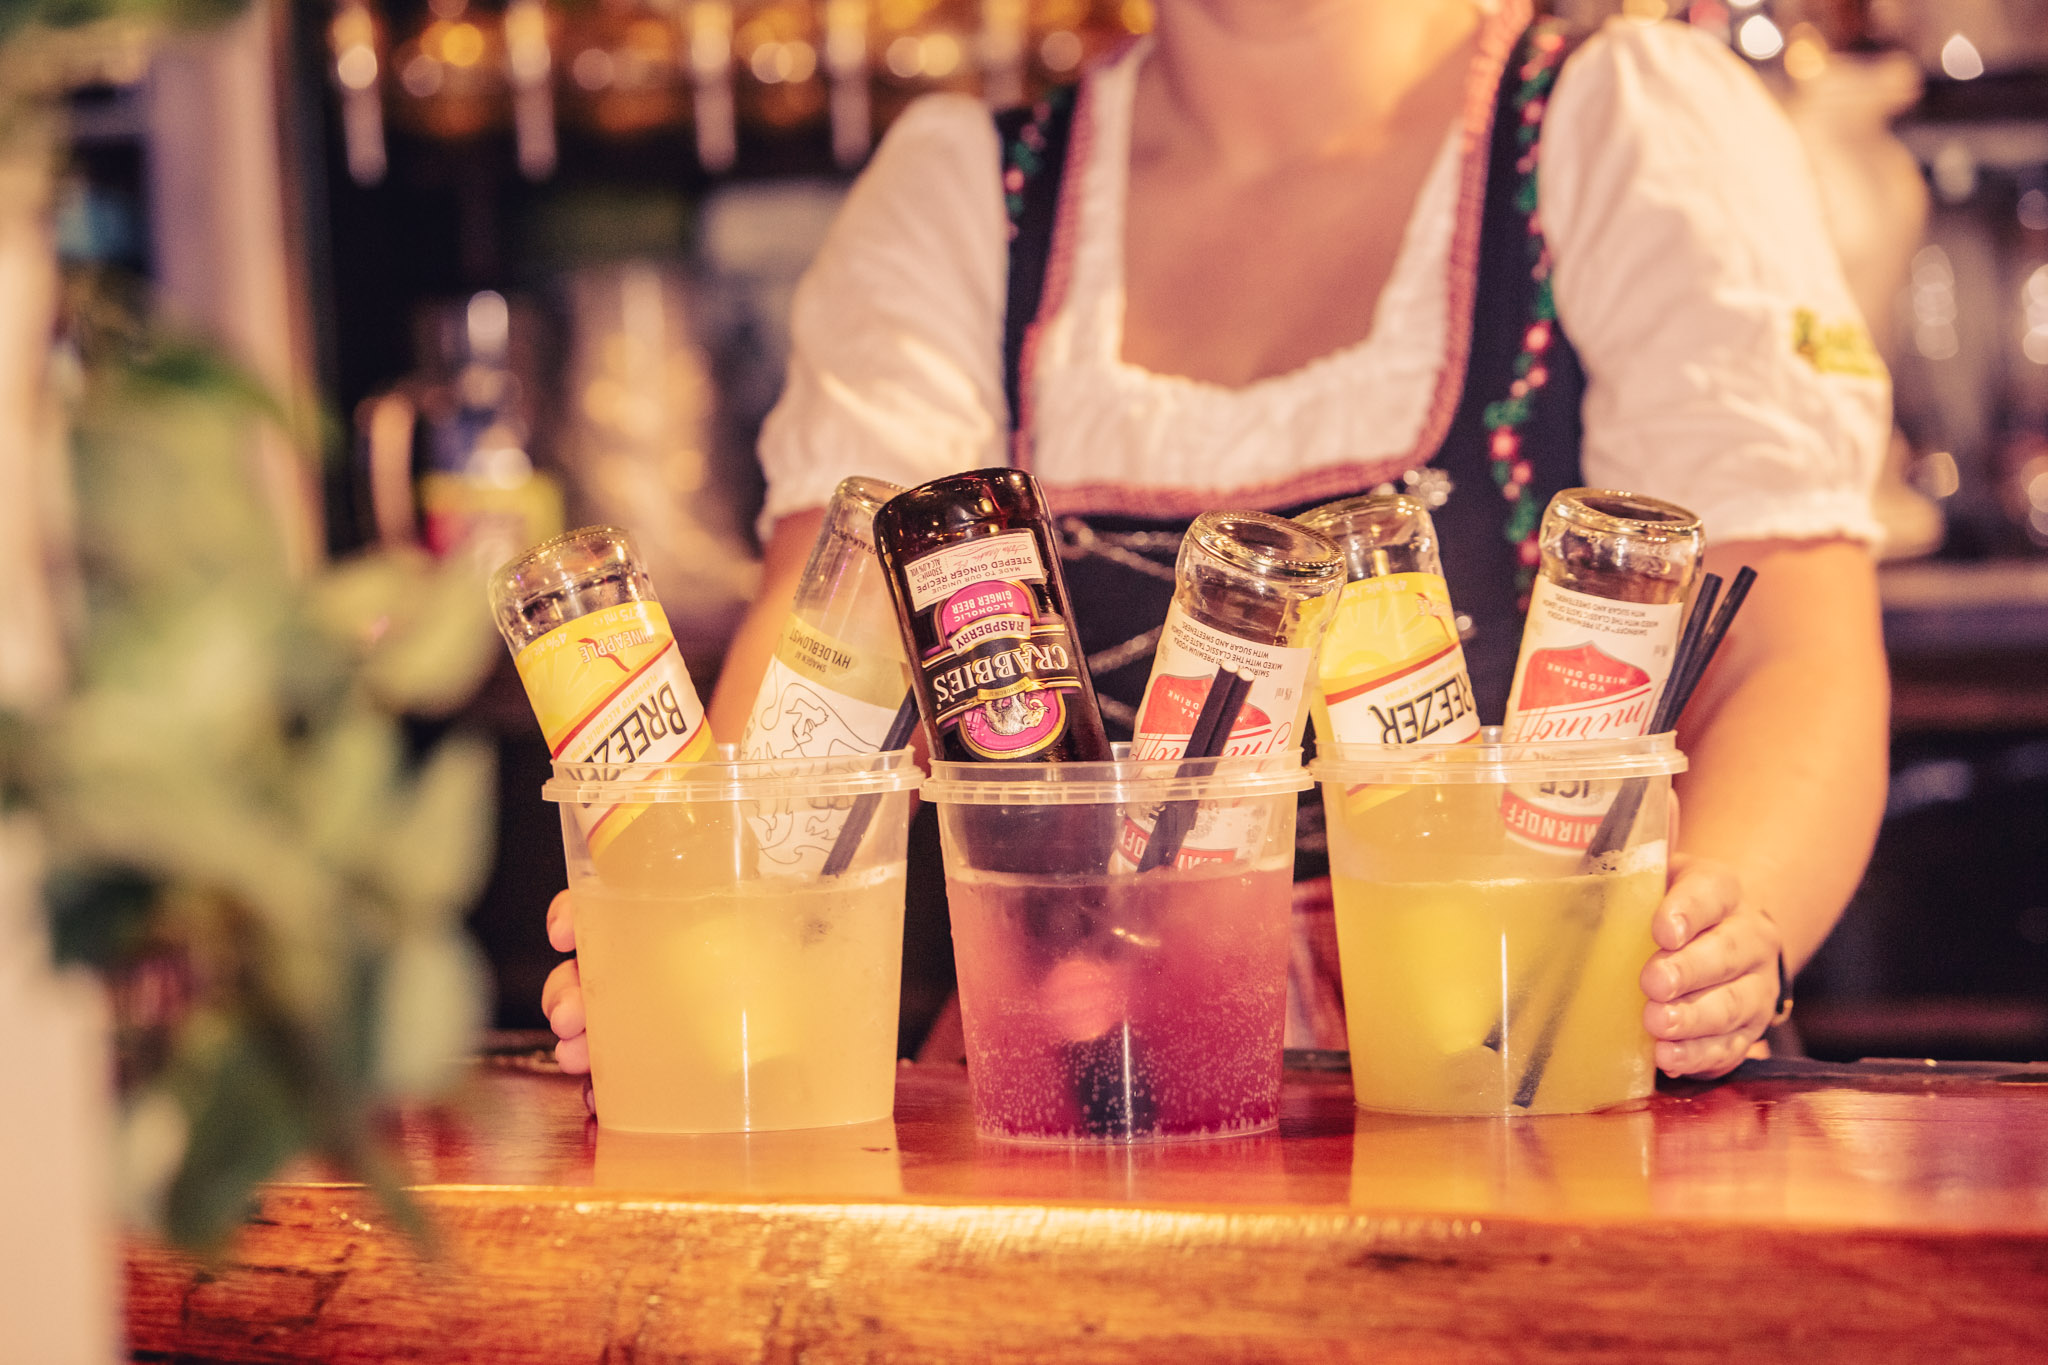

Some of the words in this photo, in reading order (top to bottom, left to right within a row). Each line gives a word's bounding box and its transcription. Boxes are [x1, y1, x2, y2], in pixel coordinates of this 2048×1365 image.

[930, 557, 941, 567] ALC
[990, 556, 1032, 569] STEEPED
[998, 565, 1020, 574] MADE
[949, 562, 988, 580] GINGER
[964, 573, 982, 582] OUR
[916, 574, 947, 593] RECIPE
[931, 579, 961, 594] UNIQUE
[976, 589, 1012, 606] GINGER
[950, 598, 976, 614] BEER
[952, 600, 1014, 622] ALCOHOLIC
[954, 620, 1024, 649] RASPBERRY
[1182, 634, 1189, 642] OF
[1215, 637, 1229, 647] AND
[578, 626, 654, 663] PINEAPPLE
[788, 627, 852, 669] HYLDEBLOMST
[1188, 636, 1204, 650] TASTE
[1230, 643, 1252, 654] SUGAR
[1188, 646, 1214, 662] PREMIUM
[1205, 644, 1231, 659] CLASSIC
[1231, 654, 1244, 662] THE
[1253, 649, 1269, 658] WITH
[802, 654, 826, 672] SMAGEN
[1246, 657, 1261, 666] WITH
[1263, 660, 1282, 670] MIXED
[930, 642, 1070, 703] CRABBIE'S
[1545, 662, 1583, 677] DRINK
[1562, 676, 1605, 691] VODKA
[1588, 672, 1626, 685] MIXED
[1166, 688, 1199, 708] DRINK
[1367, 672, 1472, 749] REEZER
[1506, 802, 1597, 845] MIRNOFF
